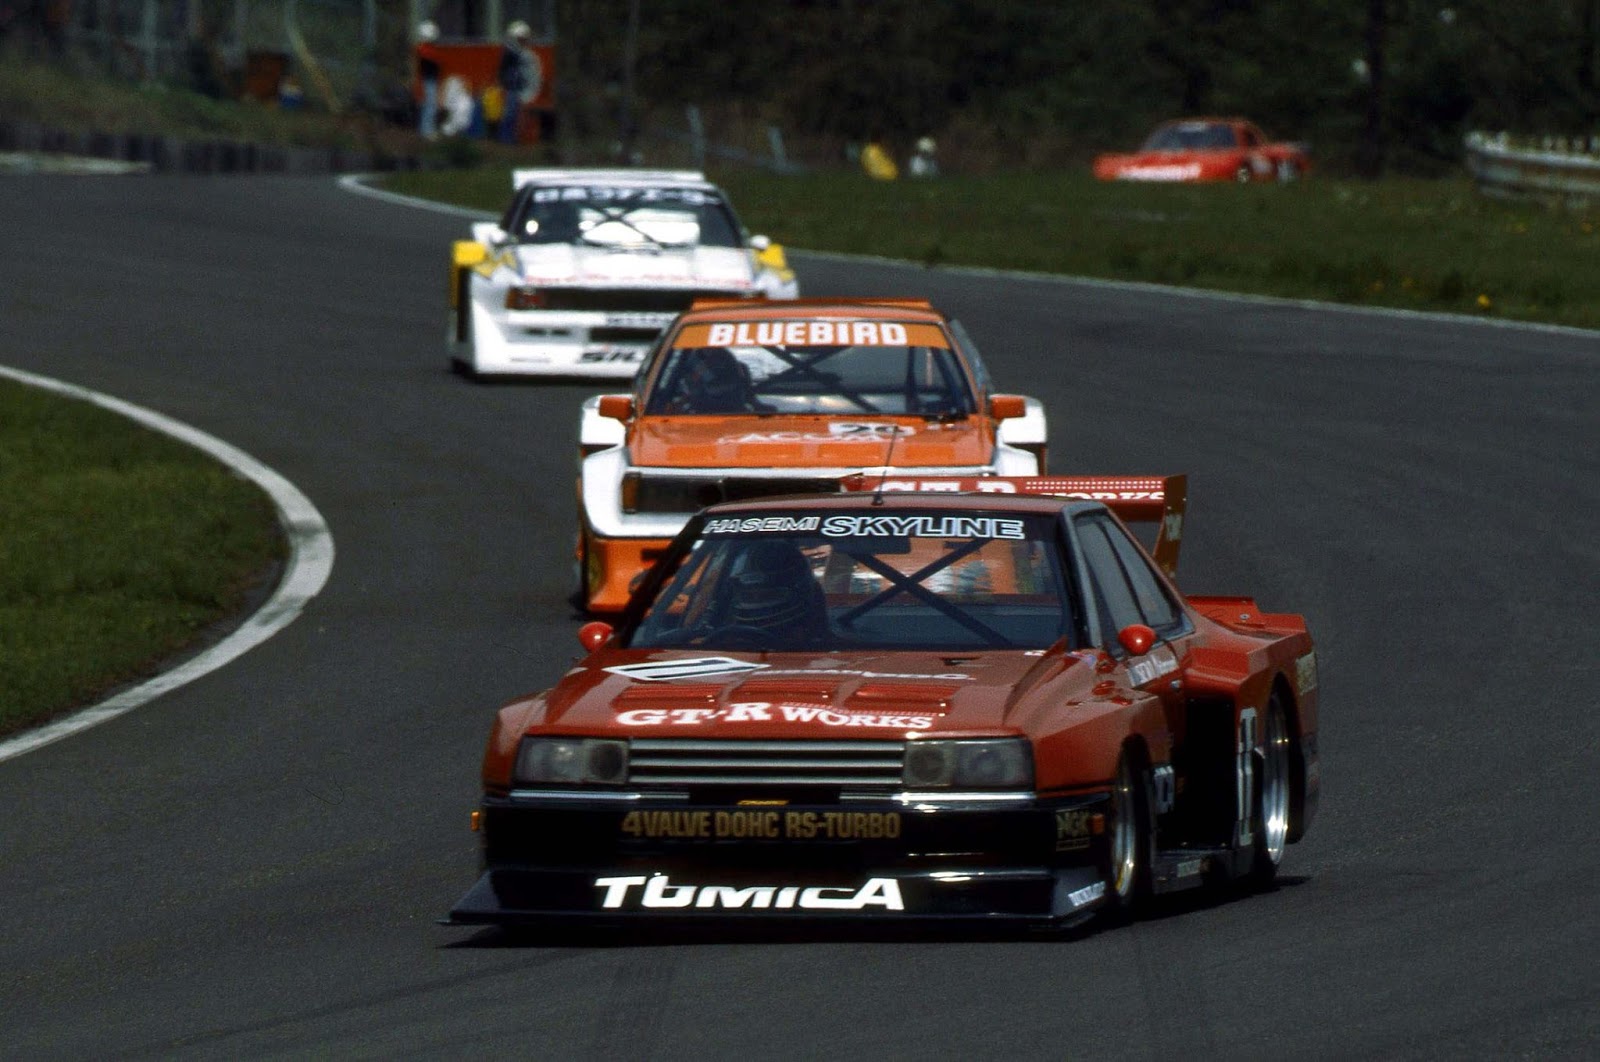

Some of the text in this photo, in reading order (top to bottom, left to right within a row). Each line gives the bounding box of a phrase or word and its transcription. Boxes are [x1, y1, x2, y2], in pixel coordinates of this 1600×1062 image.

[707, 321, 907, 346] BLUEBIRD
[702, 516, 1025, 539] HASEMI SKYLINE
[615, 702, 935, 729] GT-R WORKS
[621, 811, 900, 838] 4VALVE DOHC RS-TURBO
